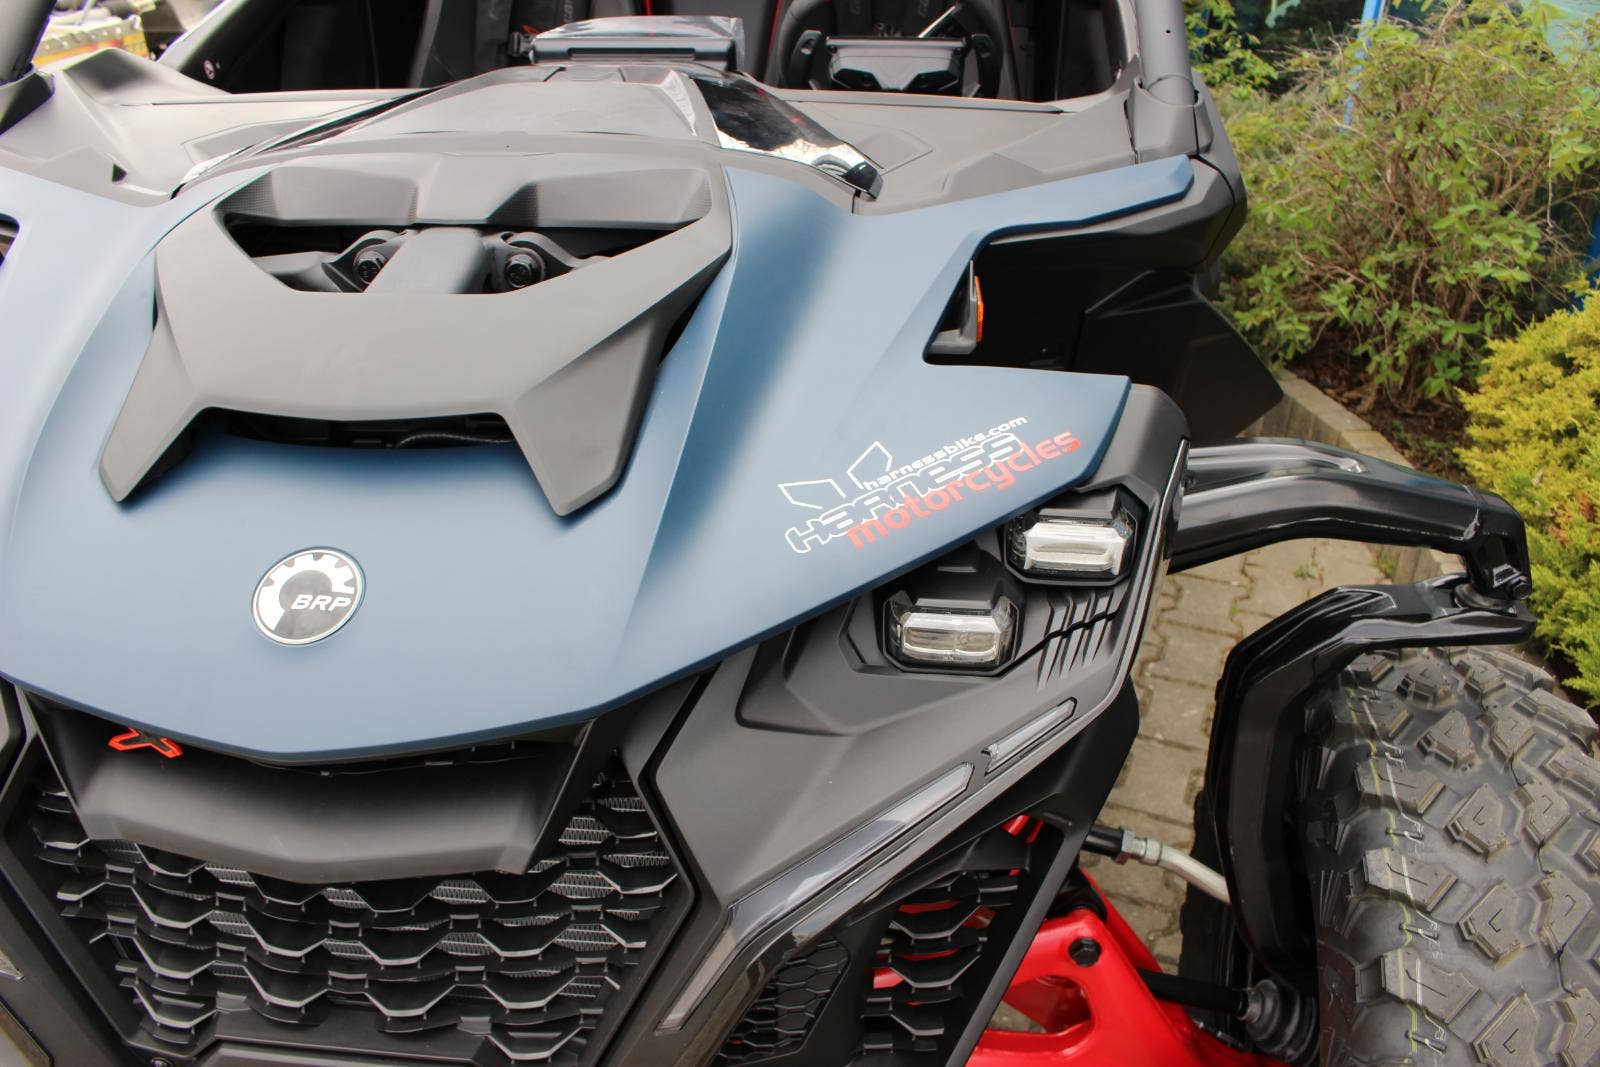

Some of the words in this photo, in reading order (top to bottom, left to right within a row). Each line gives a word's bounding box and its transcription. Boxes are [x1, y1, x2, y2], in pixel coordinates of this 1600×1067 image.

[846, 431, 1082, 550] motorcycles
[863, 416, 1028, 491] harnessbike.com
[290, 594, 352, 612] BRP
